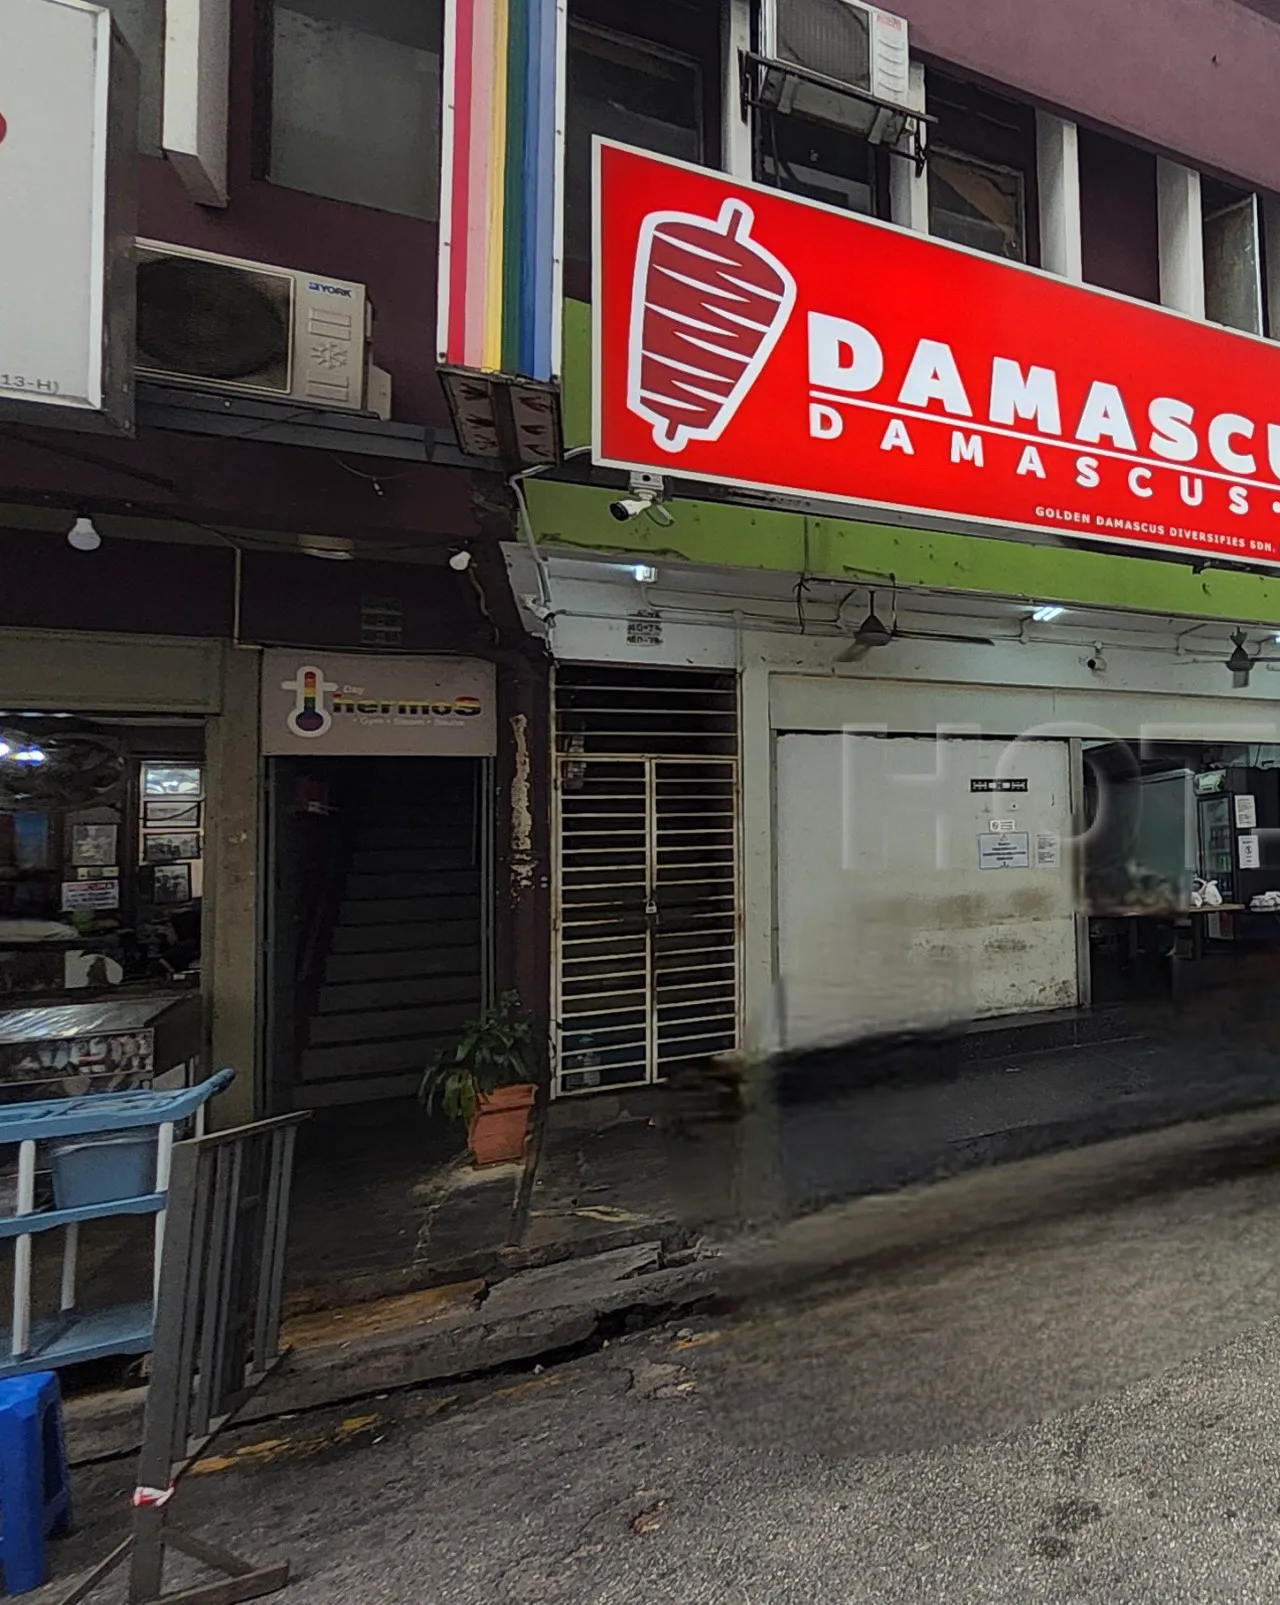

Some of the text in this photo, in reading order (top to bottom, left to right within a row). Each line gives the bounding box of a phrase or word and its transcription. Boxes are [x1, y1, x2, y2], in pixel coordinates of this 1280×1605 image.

[1035, 505, 1091, 525] GOLDEN
[1096, 515, 1165, 536] DAMASCUS
[1169, 526, 1246, 549] DIVERSIFIES
